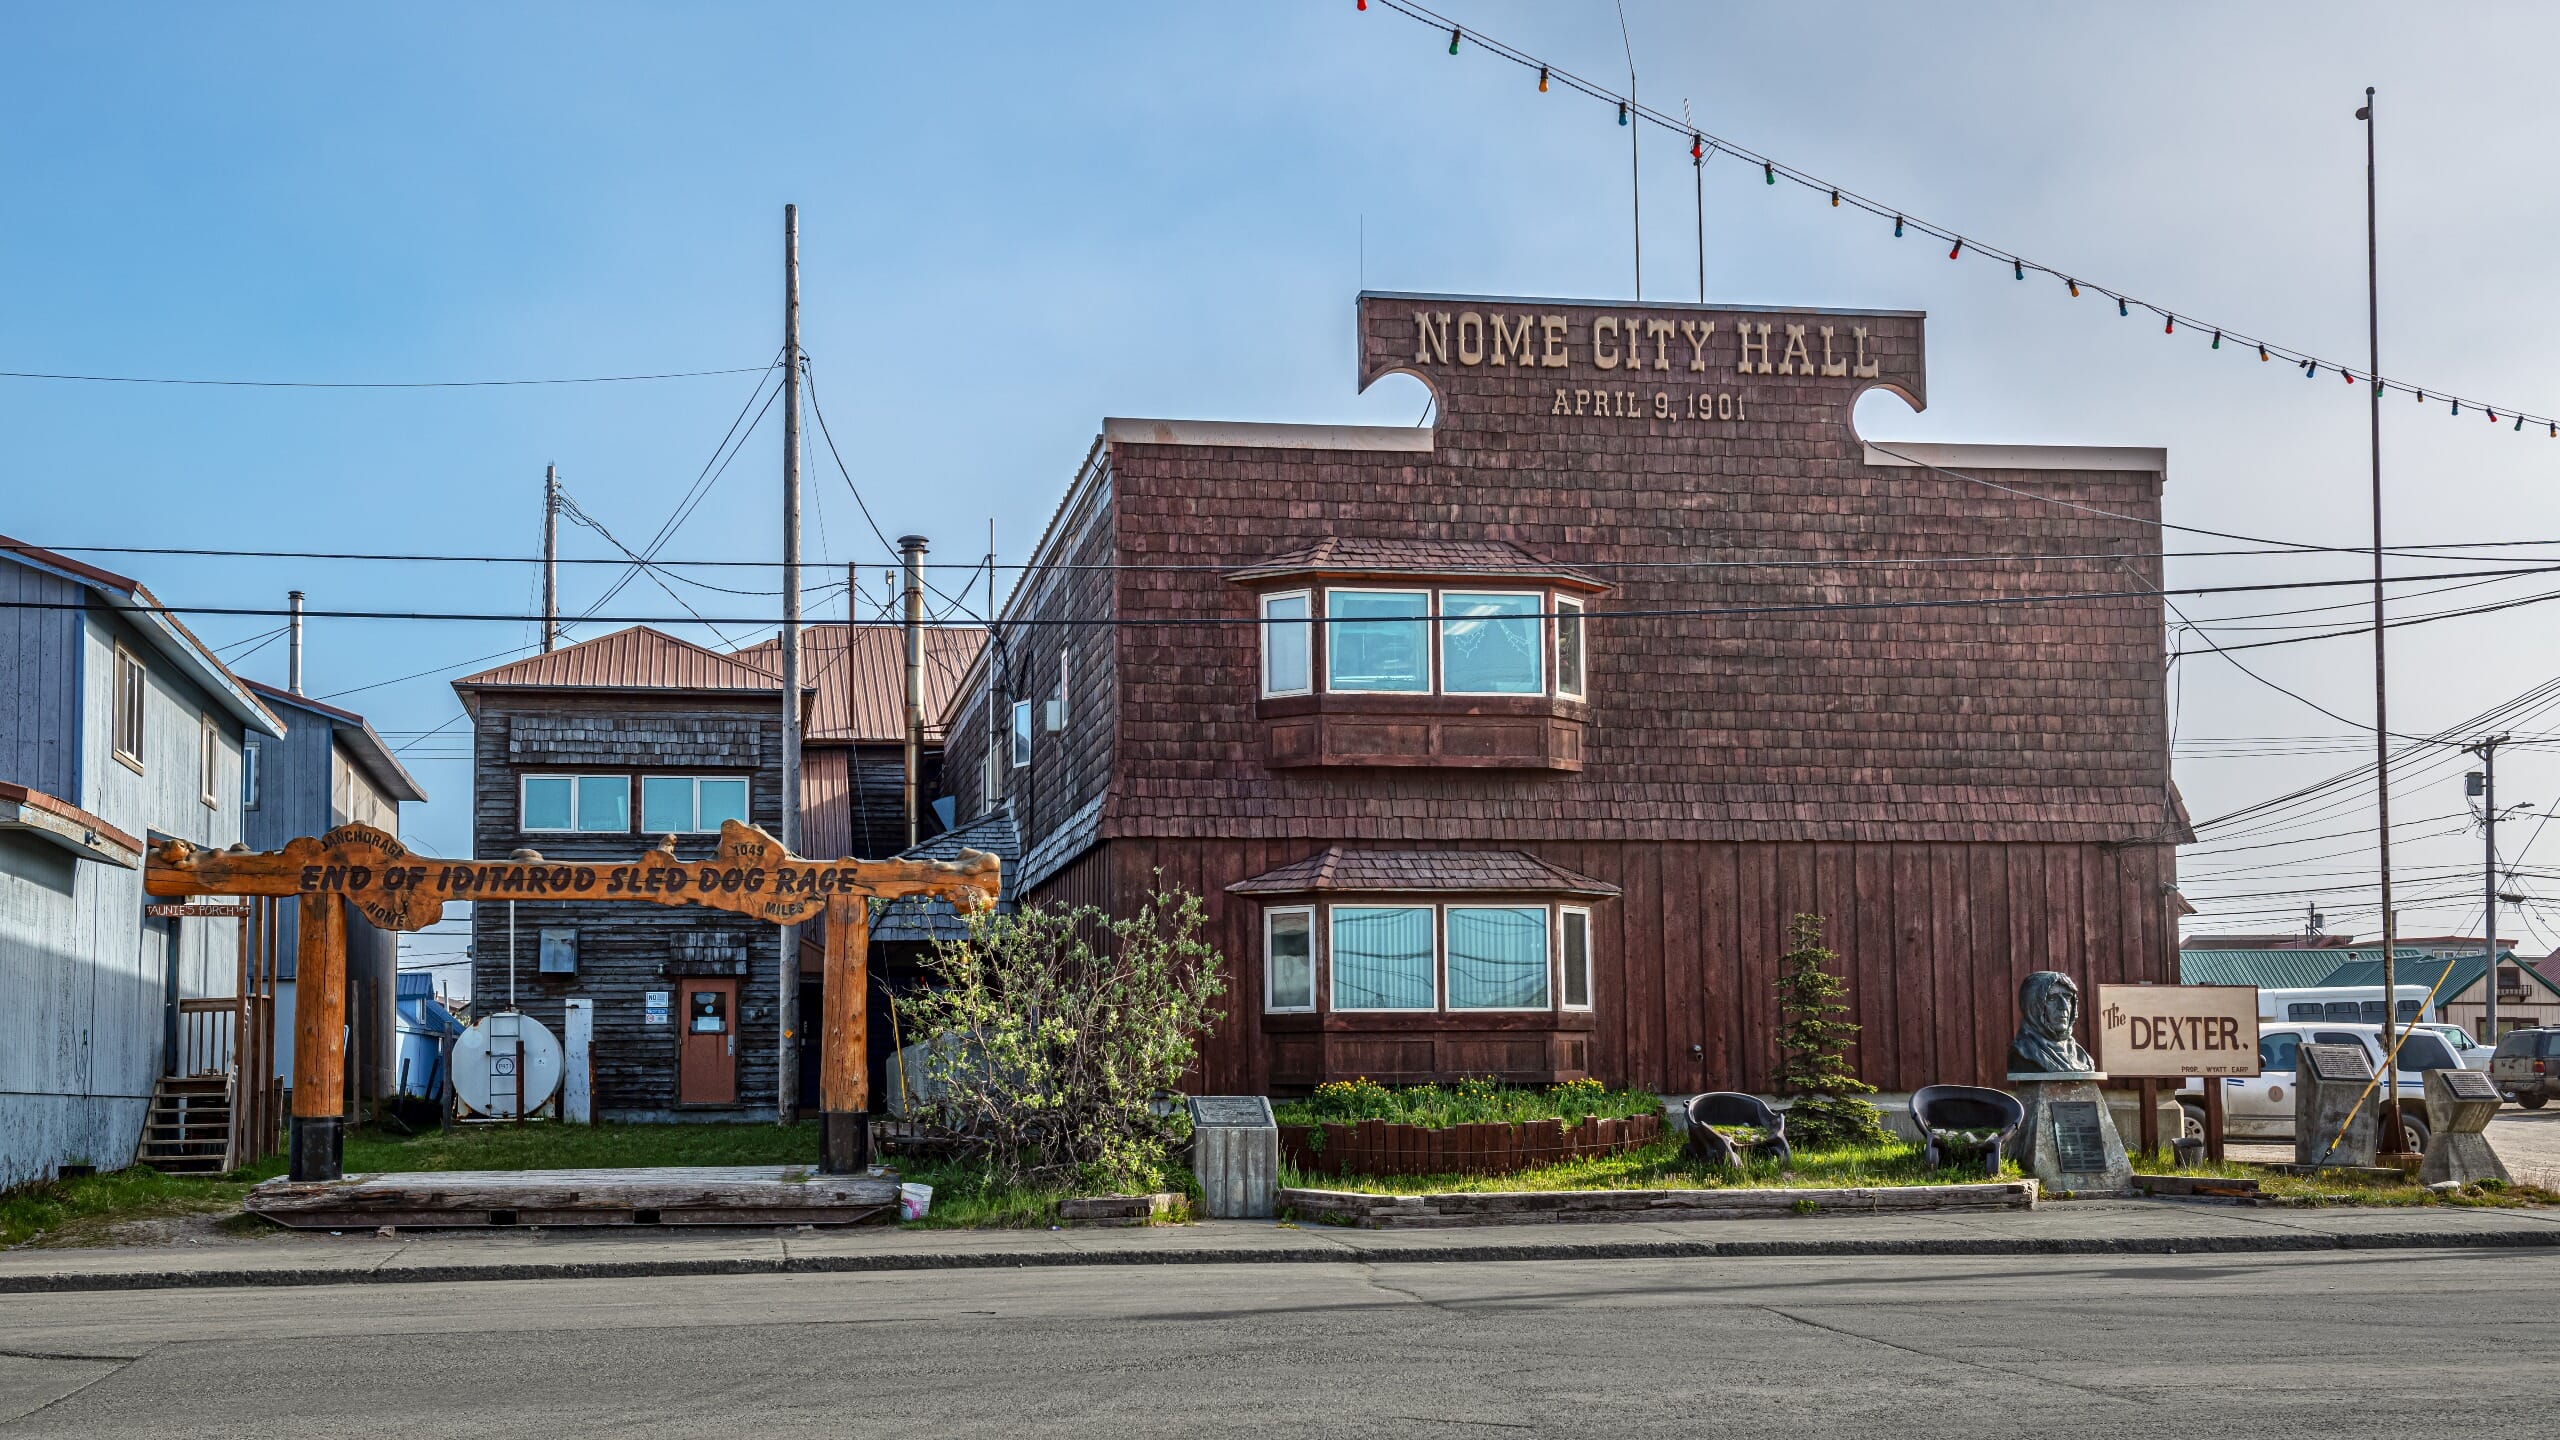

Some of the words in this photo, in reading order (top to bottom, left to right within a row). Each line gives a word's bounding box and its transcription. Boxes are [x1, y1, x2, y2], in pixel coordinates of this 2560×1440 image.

[1414, 311, 1568, 369] NOME
[1593, 315, 1715, 372] CITY
[1737, 322, 1879, 379] HALL
[1552, 389, 1641, 418] APRIL
[1687, 393, 1745, 421] 1901
[733, 843, 765, 857] 1049
[300, 865, 371, 892] END
[383, 866, 427, 892] OF
[436, 866, 597, 893] IDITAROD
[606, 867, 688, 893] SLED
[698, 867, 765, 893] DOG
[775, 867, 858, 894] RACE
[199, 905, 234, 916] PORCH
[366, 901, 405, 927] NOME
[764, 901, 805, 916] MILES
[2102, 1002, 2126, 1030] The
